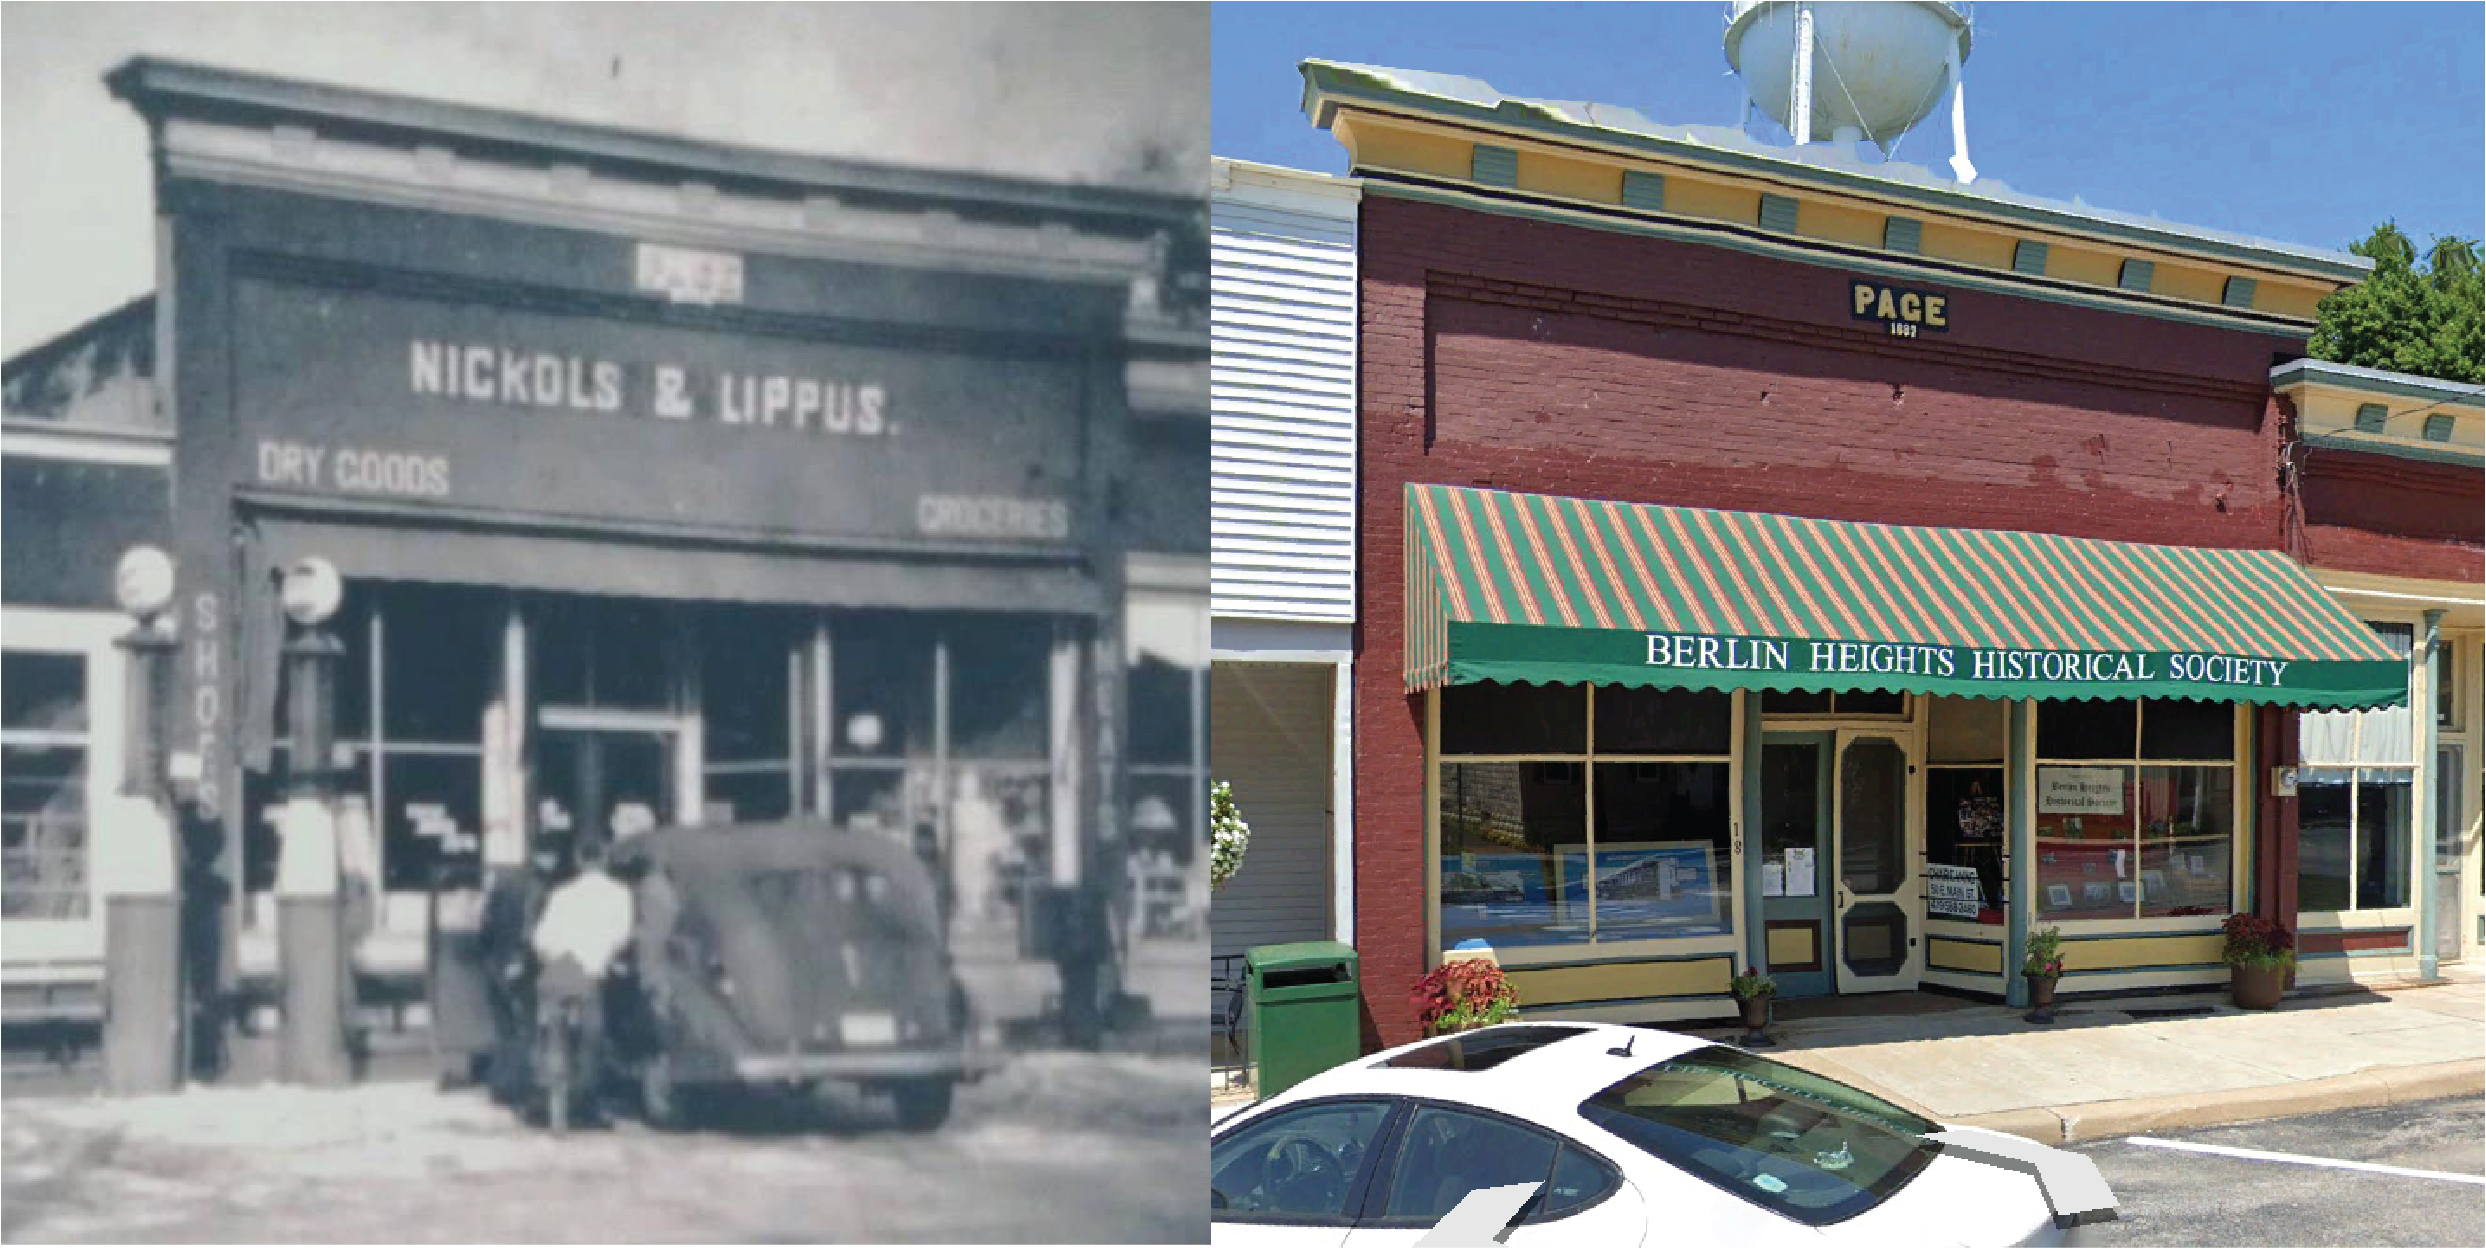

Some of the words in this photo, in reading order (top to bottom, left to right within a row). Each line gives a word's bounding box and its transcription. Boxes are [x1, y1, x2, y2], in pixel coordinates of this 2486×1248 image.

[1854, 285, 1946, 327] PAGE
[410, 338, 622, 412] NICKOLS
[655, 363, 693, 420] &
[719, 372, 902, 436] LIPPUS.
[258, 441, 325, 486] DRY
[335, 448, 450, 497] GOODS
[918, 494, 1068, 539] GROCERIES
[1645, 634, 1789, 670] BERLIN
[1809, 641, 1955, 677] HEIGHTS
[1972, 650, 2156, 681] HISTORICAL
[2169, 654, 2288, 686] SOCIETY
[1733, 822, 1742, 855] 18
